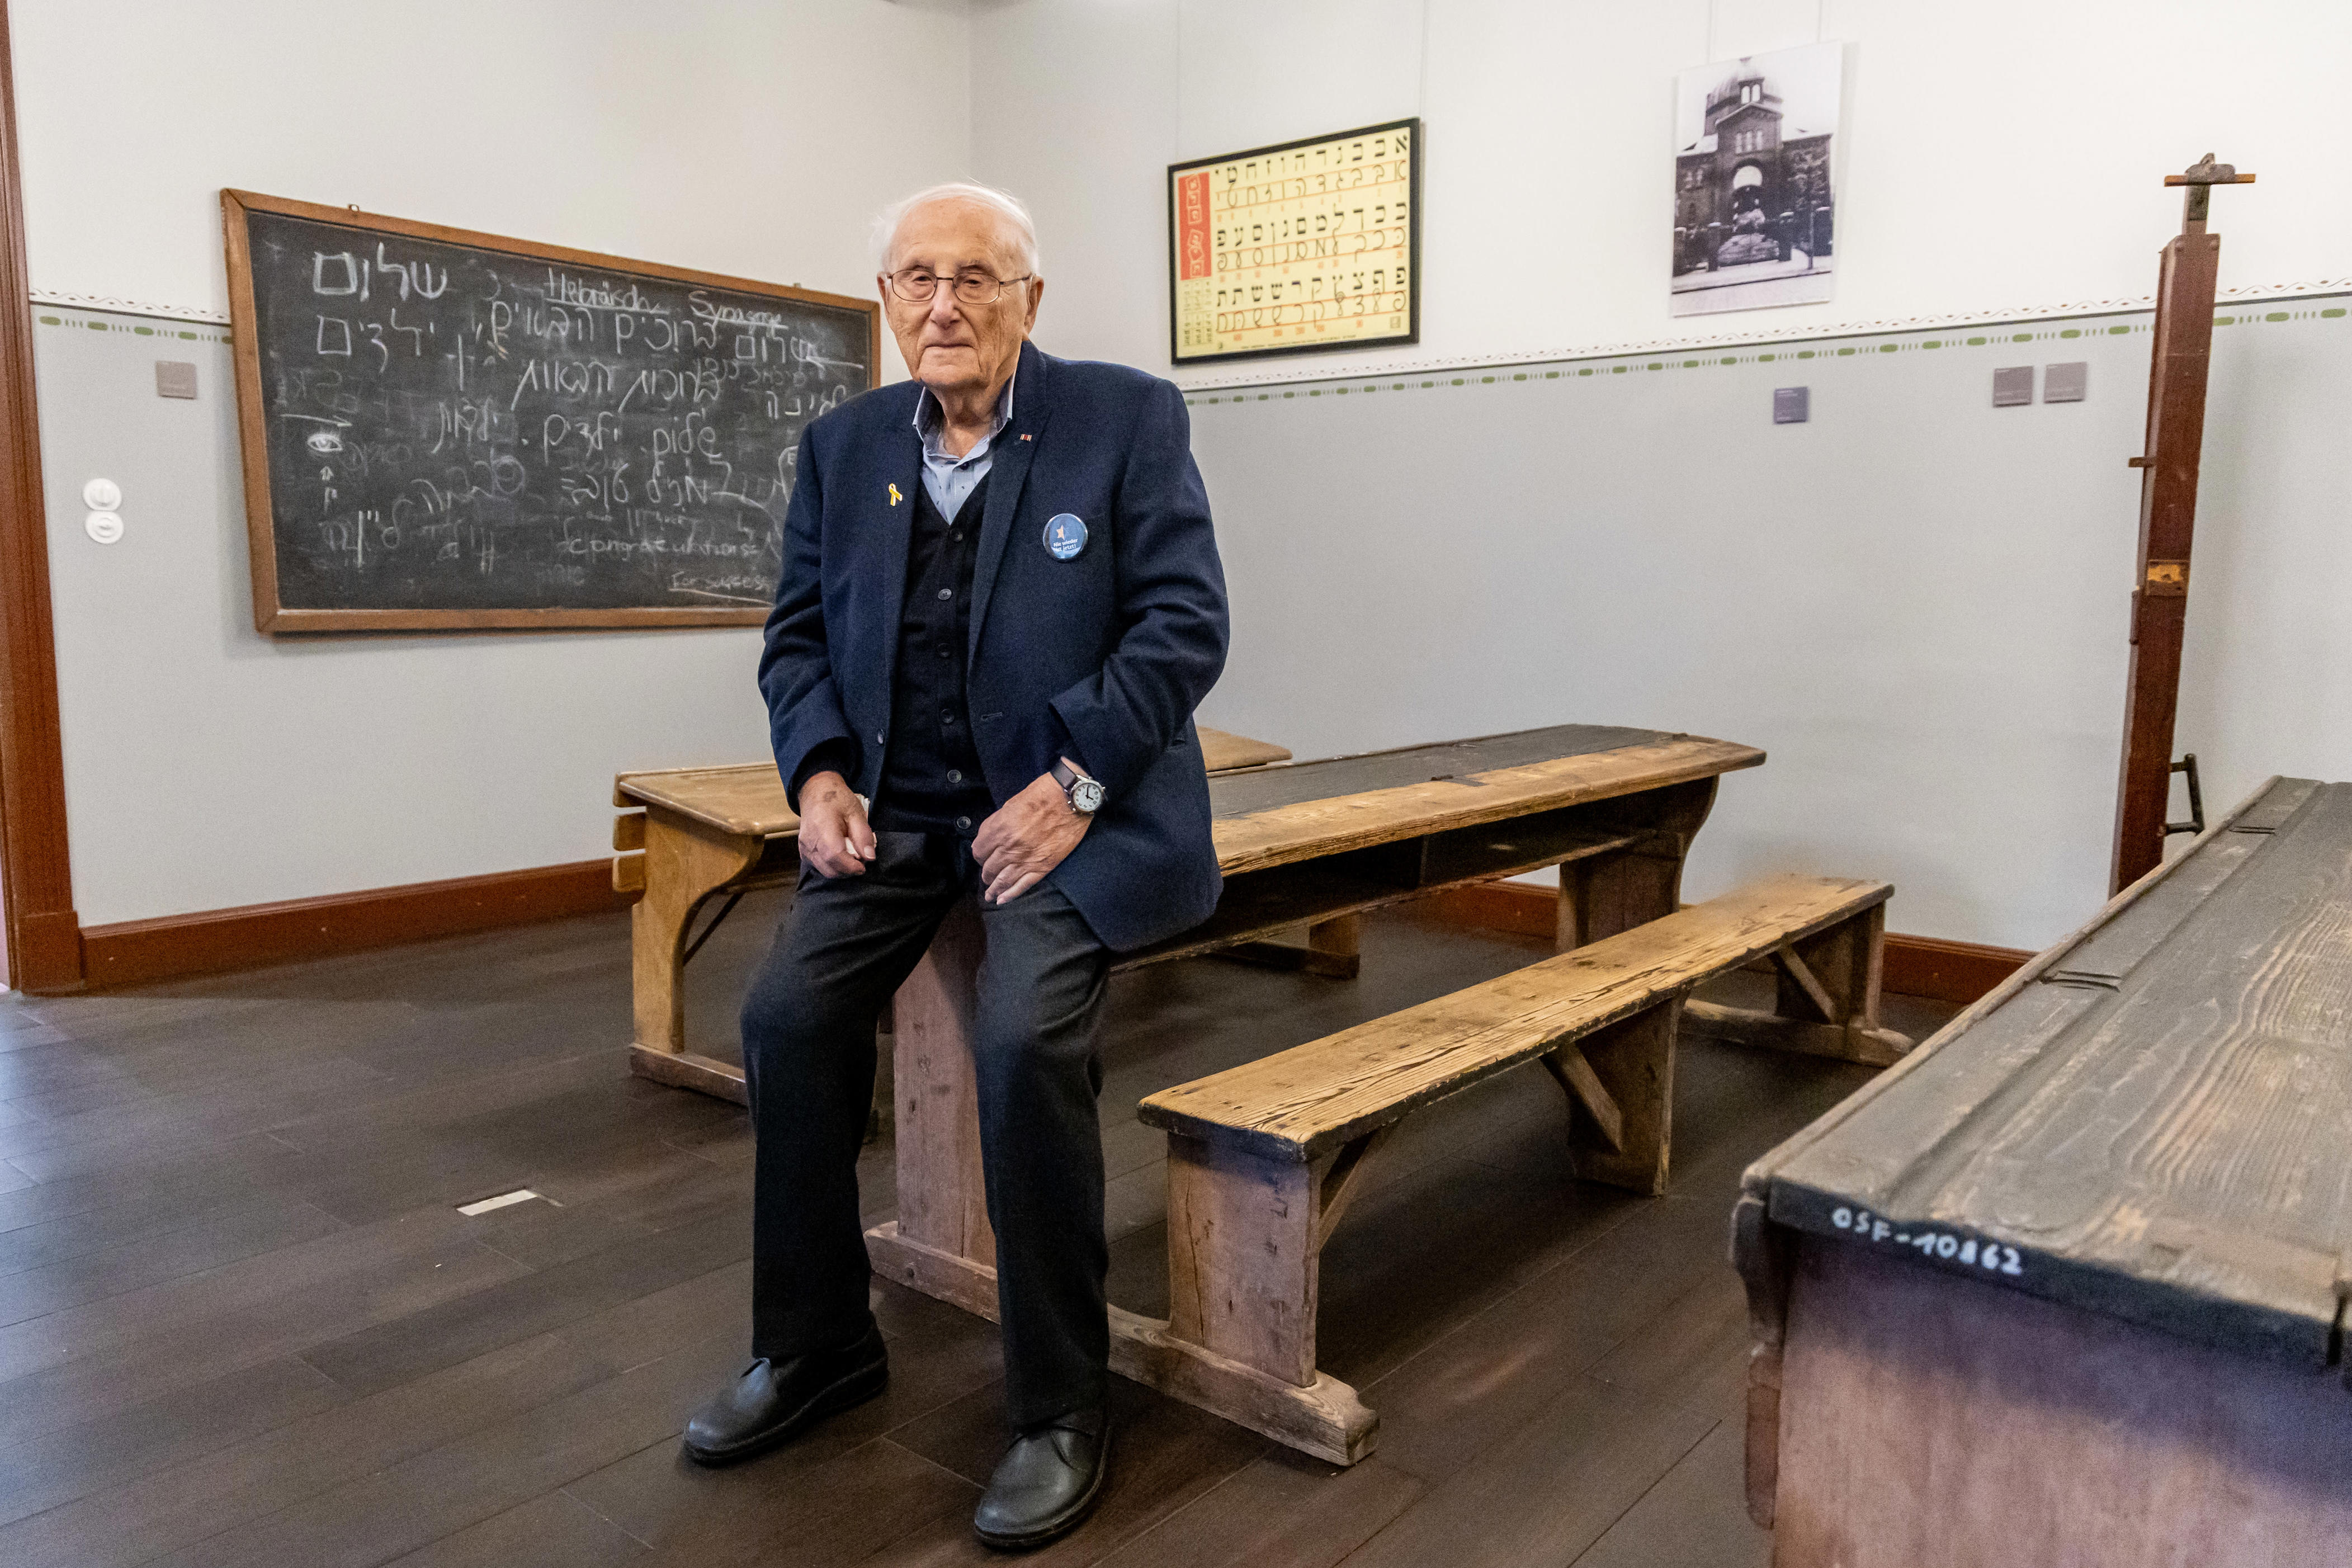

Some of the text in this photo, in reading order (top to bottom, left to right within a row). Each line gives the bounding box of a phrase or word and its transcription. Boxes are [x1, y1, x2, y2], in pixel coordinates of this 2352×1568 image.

[313, 242, 447, 302] שלום
[1062, 538, 1078, 546] wieder
[1062, 543, 1076, 552] jetzt!
